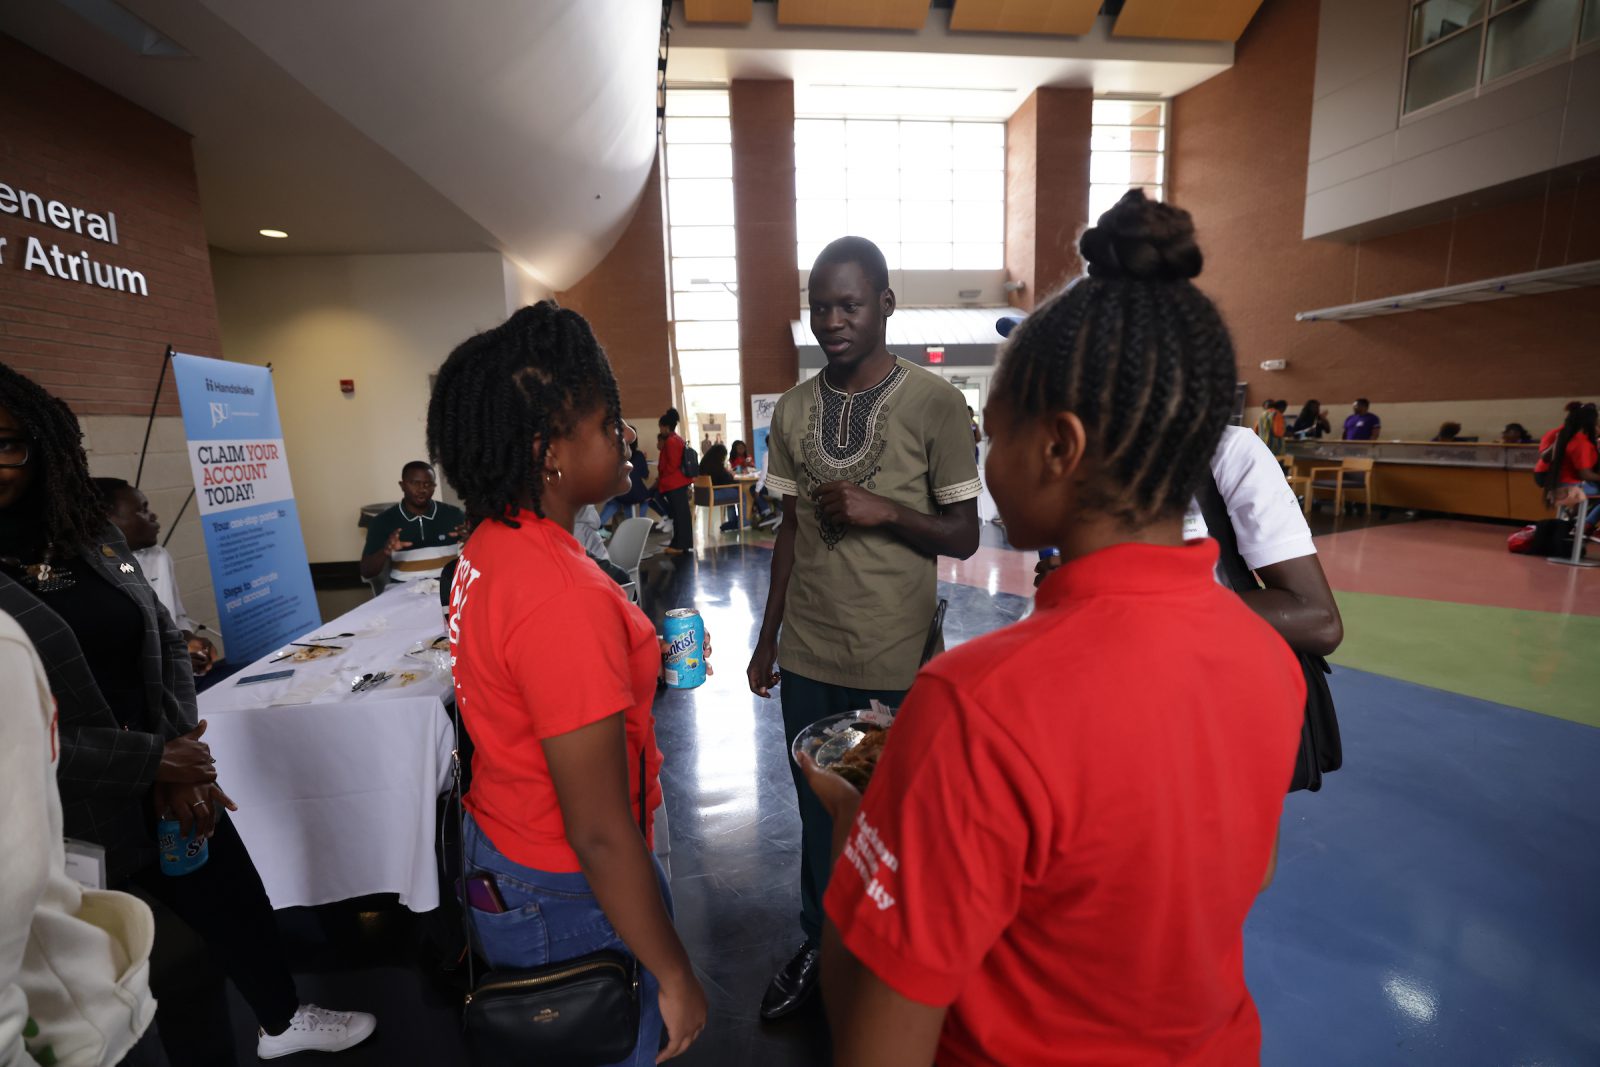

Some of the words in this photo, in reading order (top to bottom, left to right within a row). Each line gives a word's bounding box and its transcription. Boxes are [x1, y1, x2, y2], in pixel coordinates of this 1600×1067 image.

[0, 182, 118, 245] eneral
[24, 236, 149, 296] Atrium
[198, 445, 245, 465] CLAIM
[246, 443, 279, 461] YOUR
[203, 463, 268, 486] ACCOUNT
[205, 483, 255, 506] TODAY!
